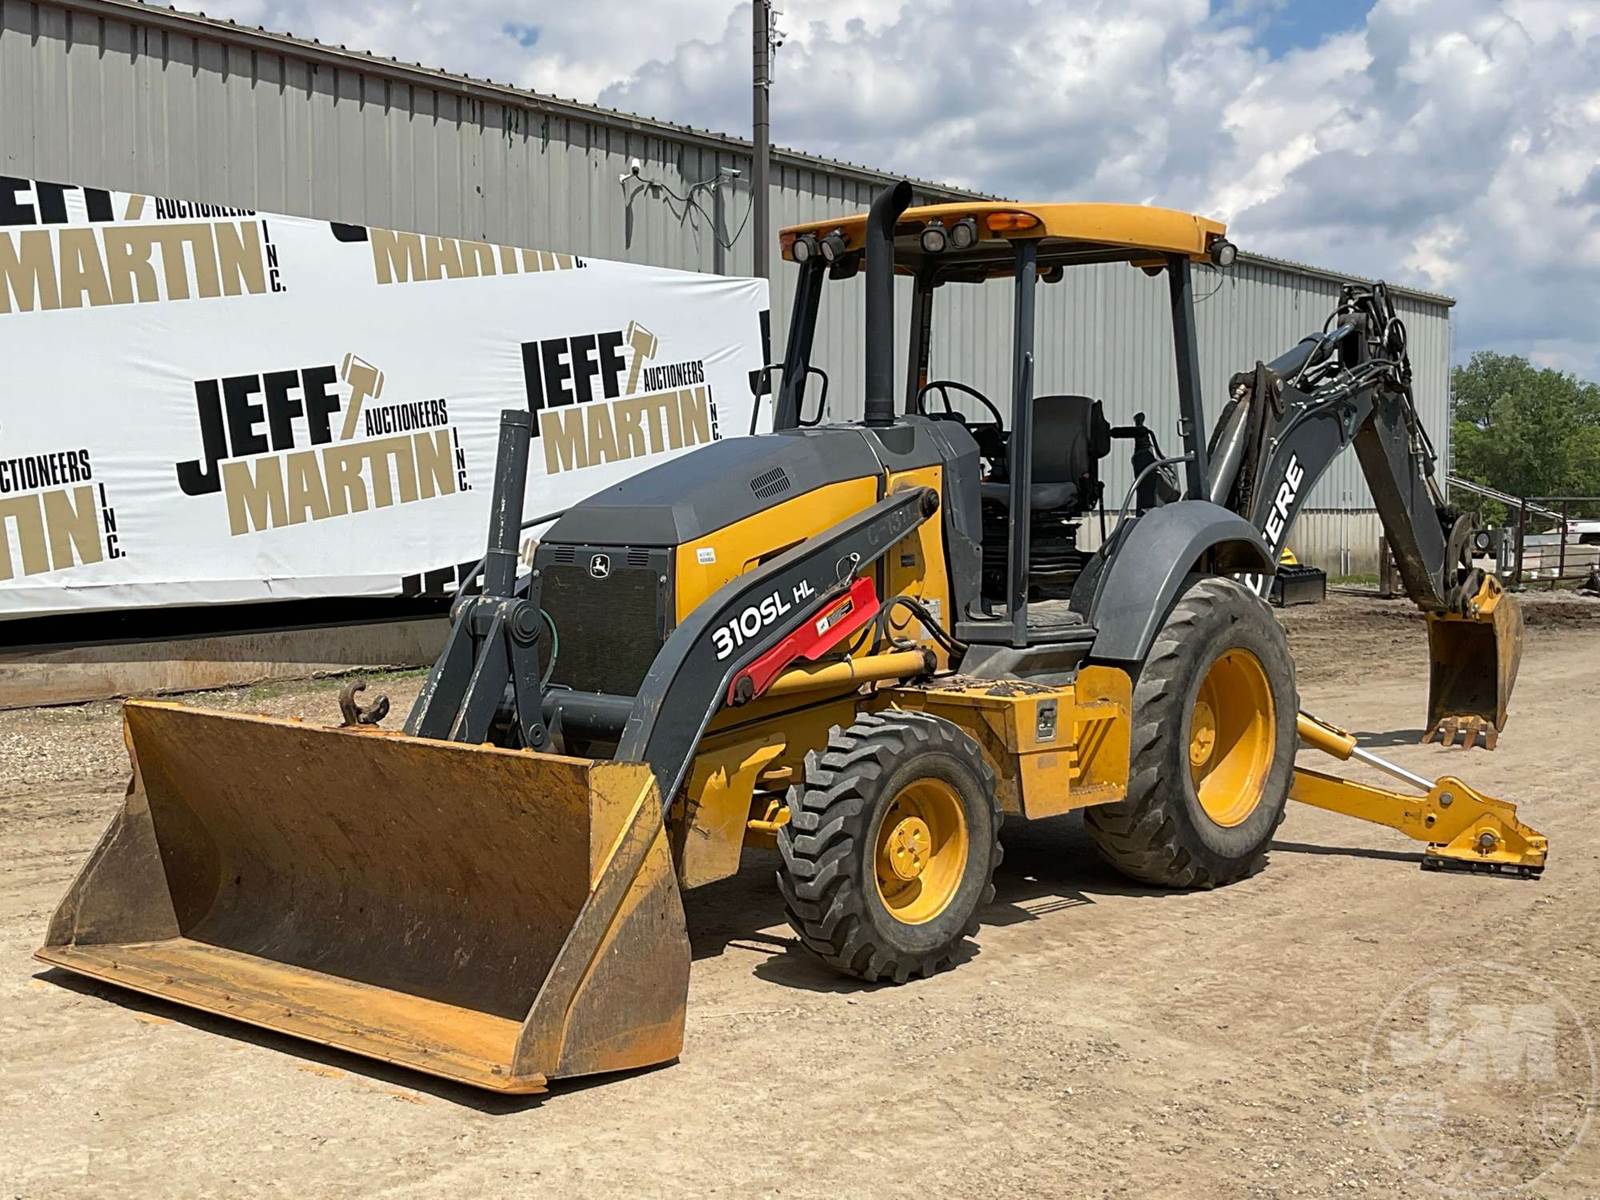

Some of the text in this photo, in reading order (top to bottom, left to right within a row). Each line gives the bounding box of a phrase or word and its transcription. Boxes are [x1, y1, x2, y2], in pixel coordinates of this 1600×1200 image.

[0, 221, 267, 314] MARTIN
[262, 219, 287, 293] INC.
[521, 330, 626, 437] JEFF
[643, 360, 705, 392] AUCTIONEERS
[707, 385, 722, 441] INC.
[175, 364, 341, 497] JEFF
[365, 398, 448, 437] AUCTIONEERS
[540, 386, 711, 475] MARTIN
[0, 449, 92, 493] CTIONEERS
[221, 428, 456, 537] MARTIN
[453, 427, 472, 492] INC.
[99, 482, 126, 560] INC.
[712, 591, 791, 660] 310SL
[792, 579, 815, 604] HL
